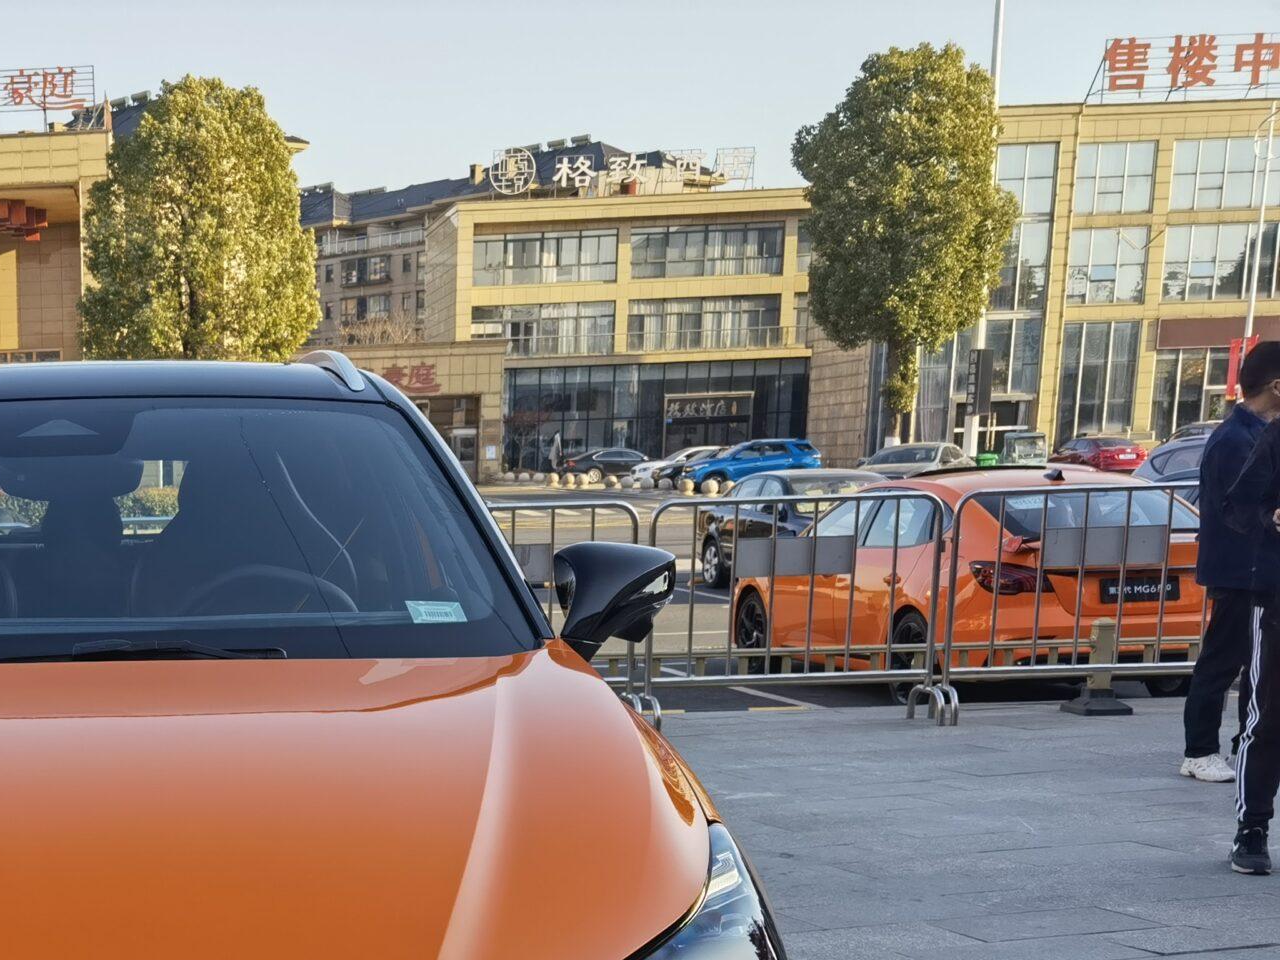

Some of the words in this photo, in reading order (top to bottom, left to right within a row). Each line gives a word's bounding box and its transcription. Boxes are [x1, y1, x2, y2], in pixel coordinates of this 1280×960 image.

[1104, 33, 1280, 91] 售楼中
[552, 151, 755, 188] 格致酒店
